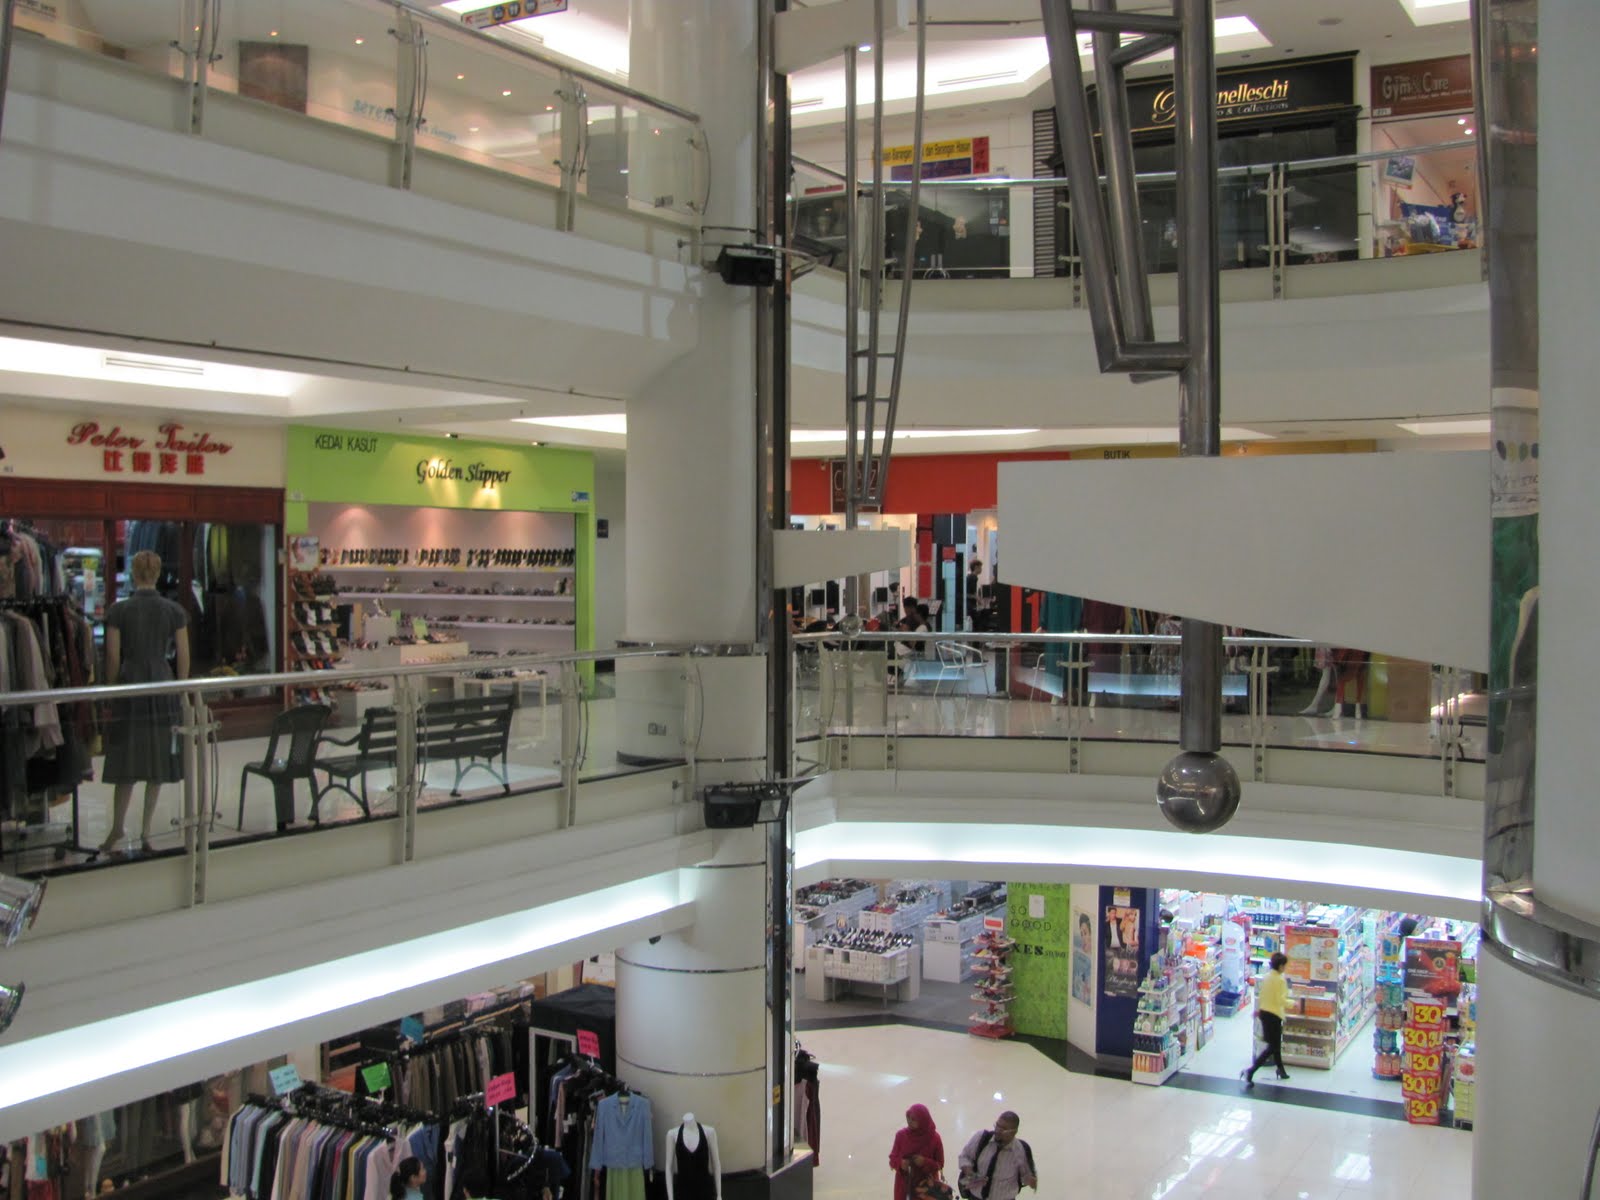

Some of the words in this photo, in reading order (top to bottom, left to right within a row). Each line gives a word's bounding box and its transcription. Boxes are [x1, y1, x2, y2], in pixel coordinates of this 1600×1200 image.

[67, 421, 145, 449] Peter
[155, 423, 233, 455] Tailor
[315, 434, 342, 450] KEDAI
[347, 436, 378, 452] KASUT
[1104, 449, 1131, 460] BUTIK
[416, 457, 463, 484] Golden
[465, 460, 512, 488] Slipper
[1010, 905, 1027, 916] SO
[1010, 918, 1052, 931] GOOD
[1415, 1005, 1441, 1024] 30
[1404, 1027, 1427, 1047] 30
[1412, 1053, 1439, 1071] 30
[1402, 1074, 1425, 1093] 30
[1410, 1099, 1437, 1117] 30
